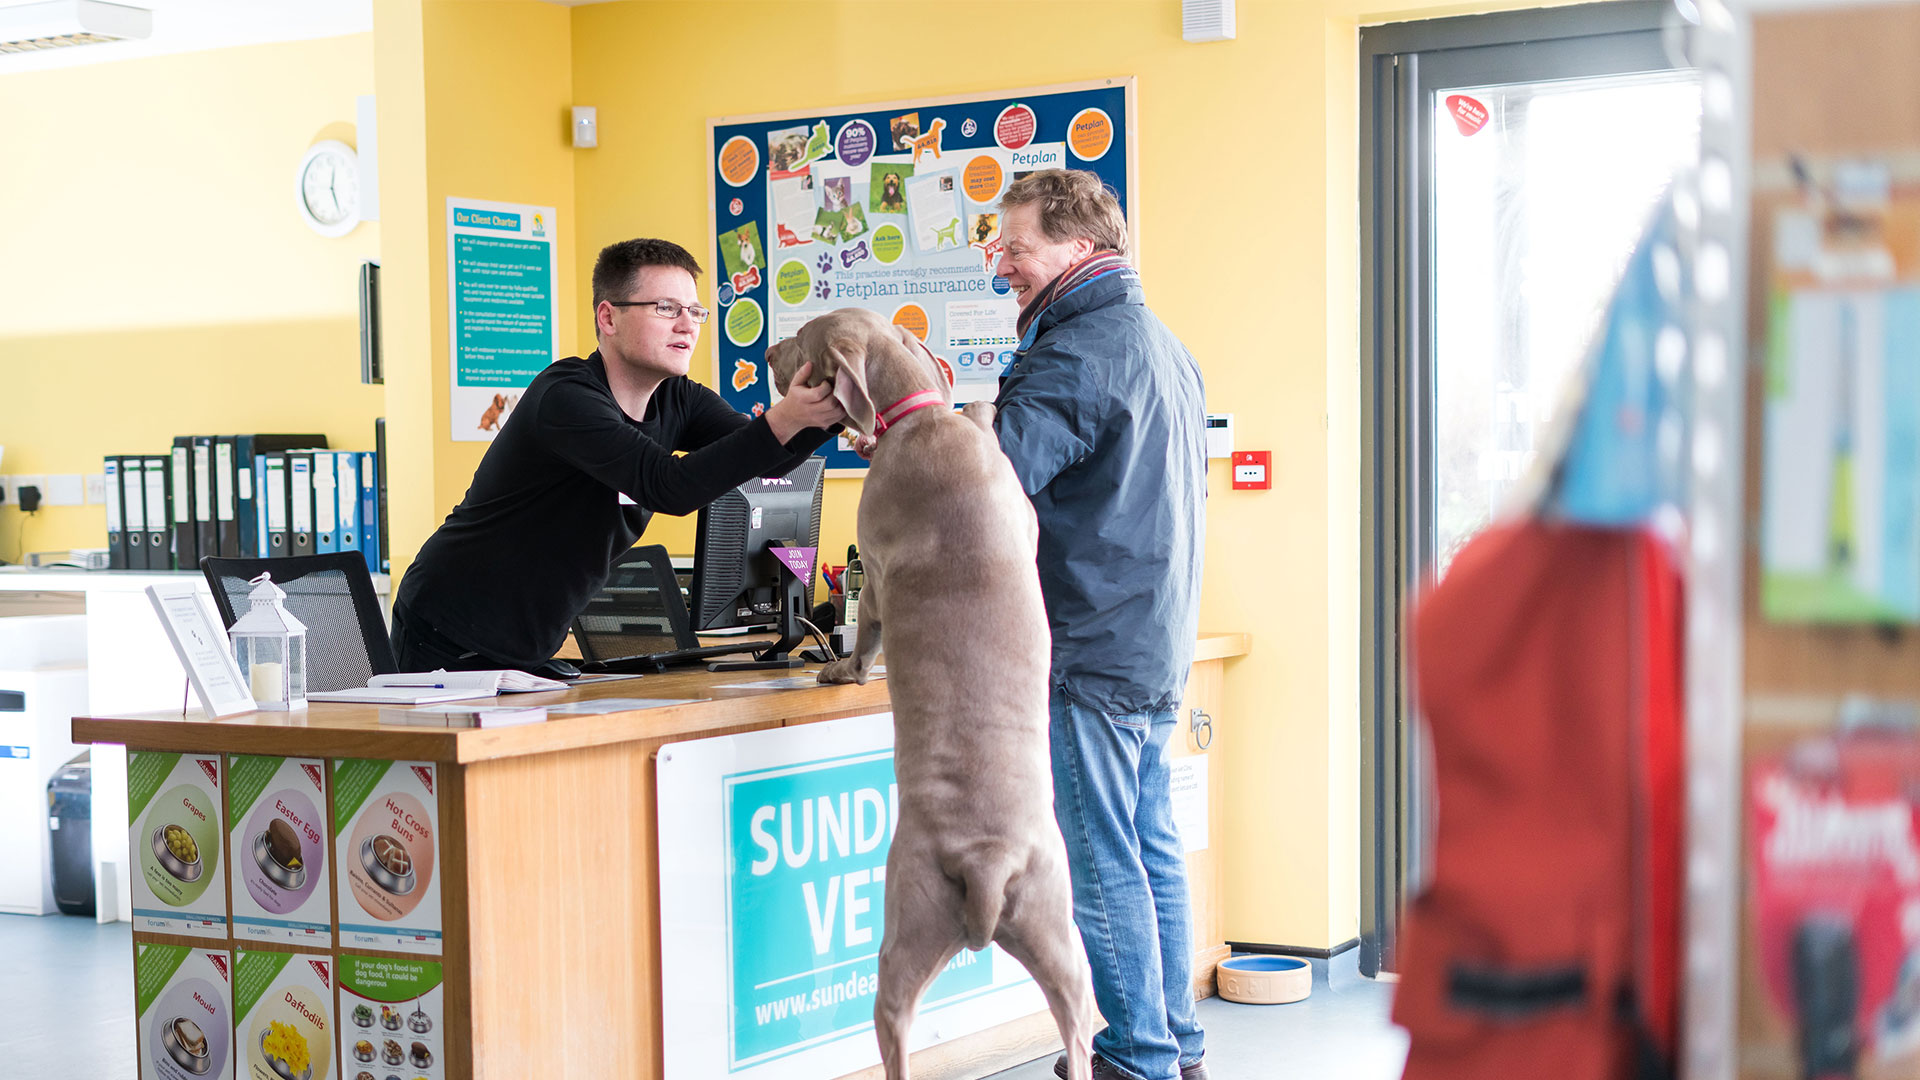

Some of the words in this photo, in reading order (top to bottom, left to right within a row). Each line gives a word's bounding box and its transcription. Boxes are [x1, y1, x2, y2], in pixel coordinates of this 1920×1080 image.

[846, 127, 865, 138] 90%
[1075, 119, 1103, 131] Petplan
[1012, 150, 1057, 166] Petplan
[457, 212, 469, 222] Our
[471, 214, 491, 224] Client
[493, 216, 517, 227] Charter
[834, 271, 854, 280] This
[855, 269, 891, 280] practice
[892, 266, 927, 278] strongly
[835, 280, 899, 300] Petplan
[903, 278, 986, 295] insurance
[788, 550, 803, 559] JOIN
[788, 560, 809, 569] TODAY
[199, 760, 217, 783] DANGER
[303, 765, 321, 789] DANGER
[413, 767, 432, 790] DANGER
[183, 798, 206, 822] Grapes
[385, 798, 404, 818] Hot
[405, 814, 430, 838] Cross
[275, 799, 303, 826] Easter
[303, 823, 320, 844] Egg
[391, 818, 415, 843] Buns
[210, 955, 227, 977] DANGER
[311, 961, 329, 985] DANGER
[355, 969, 367, 978] dog
[376, 962, 393, 971] dog's
[410, 966, 423, 974] isn't
[355, 978, 387, 987] dangerous
[192, 992, 216, 1015] Mould
[284, 991, 324, 1030] Daffodils
